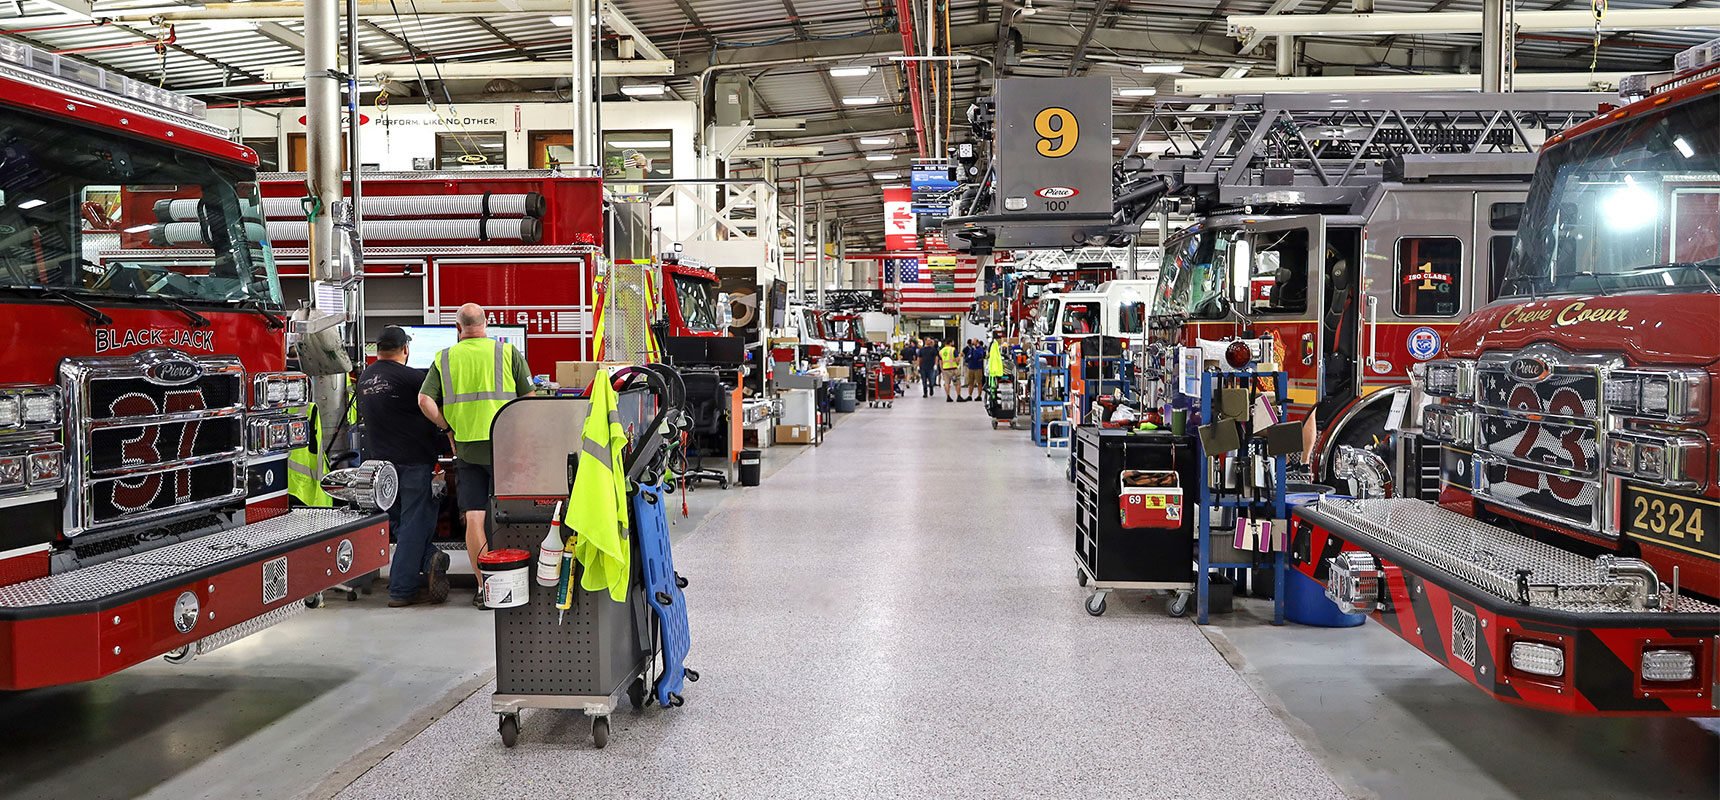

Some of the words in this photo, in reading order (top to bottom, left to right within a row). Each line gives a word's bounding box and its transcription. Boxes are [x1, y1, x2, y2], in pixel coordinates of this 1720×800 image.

[1033, 106, 1080, 158] 9
[1044, 188, 1069, 197] Pierce
[1044, 200, 1070, 212] 100'
[1408, 273, 1422, 281] ISO
[1423, 273, 1447, 281] CLASS
[1418, 261, 1437, 290] 1
[1500, 304, 1553, 329] Creve
[1556, 301, 1630, 327] Coeur
[95, 328, 163, 353] BLACK
[169, 329, 214, 352] JACK
[160, 362, 193, 379] Pierce
[1514, 360, 1539, 375] Pierce
[109, 388, 207, 513] 37
[1505, 382, 1588, 501] 23
[1128, 494, 1142, 505] 69
[1632, 495, 1705, 543] 2324
